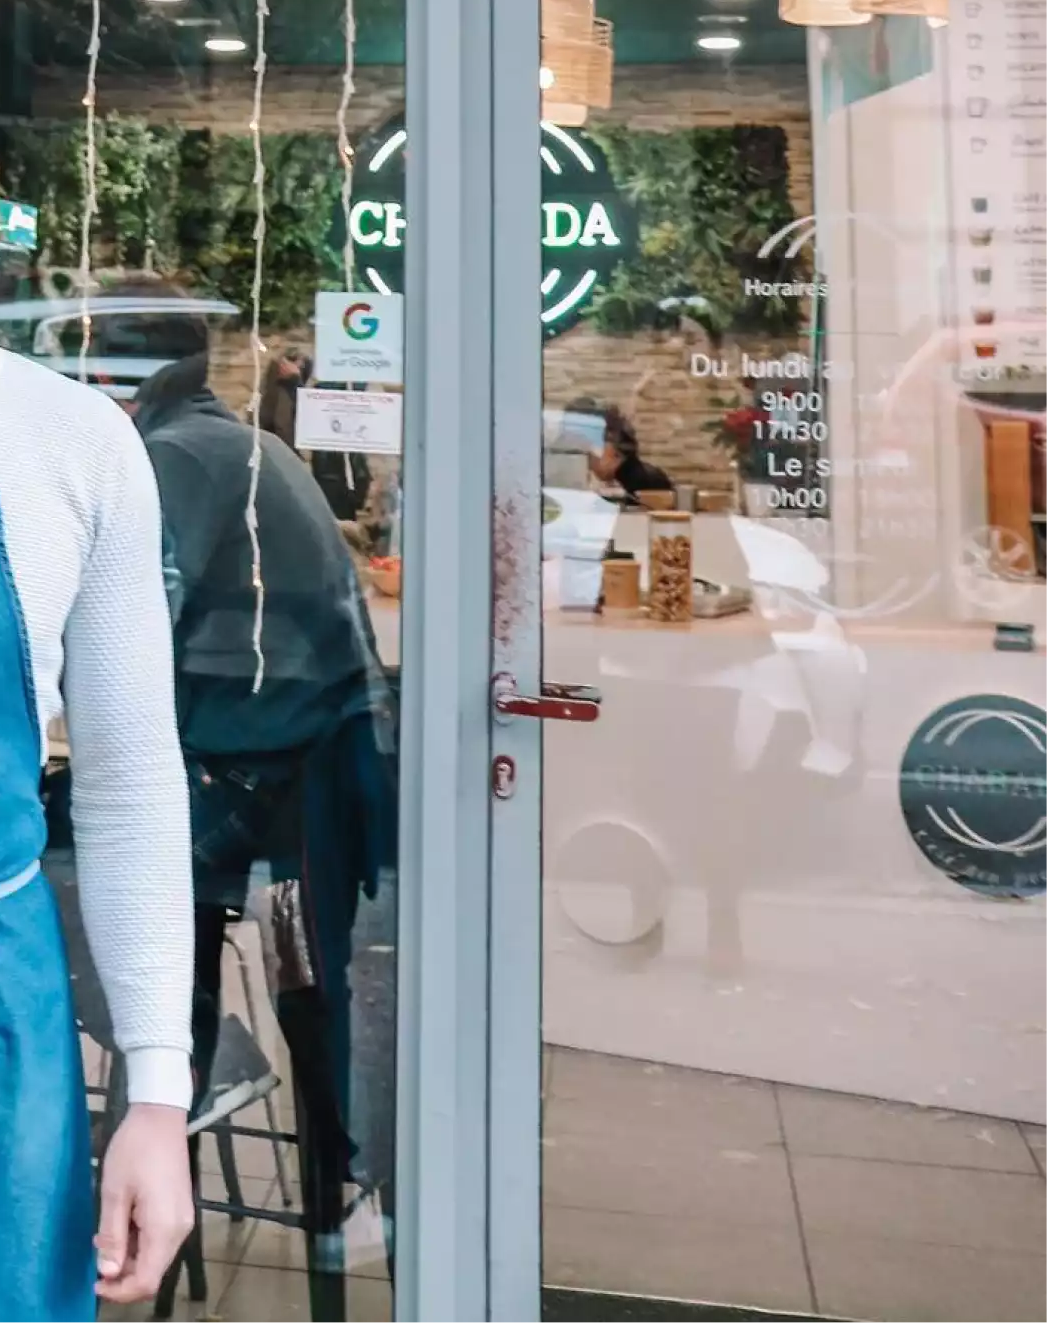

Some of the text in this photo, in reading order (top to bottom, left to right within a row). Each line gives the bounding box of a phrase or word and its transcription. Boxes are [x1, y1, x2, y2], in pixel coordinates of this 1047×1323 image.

[744, 278, 829, 297] Horaires
[690, 353, 729, 377] Du
[741, 353, 810, 379] lundi
[761, 390, 823, 412] 9h00
[753, 420, 829, 442] 17h30
[767, 452, 803, 477] Le
